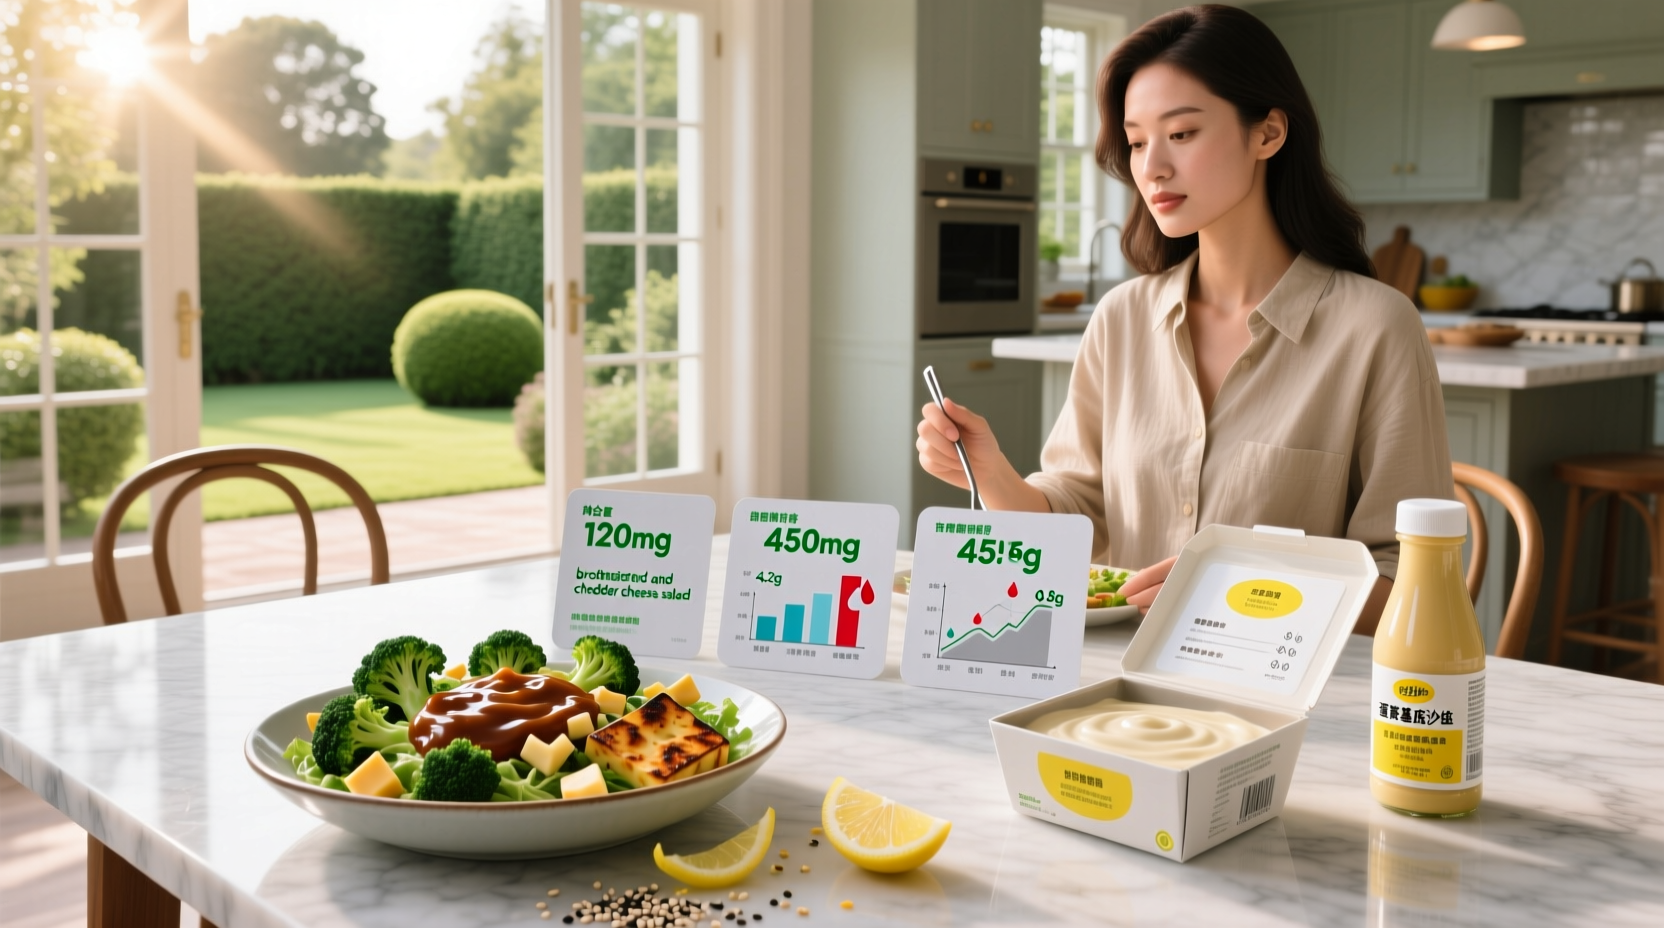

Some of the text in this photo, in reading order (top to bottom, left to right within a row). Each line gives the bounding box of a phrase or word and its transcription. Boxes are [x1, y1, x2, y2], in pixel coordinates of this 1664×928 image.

[585, 522, 672, 558] 120mg
[763, 527, 861, 563] 450mg
[651, 572, 674, 585] and
[755, 571, 783, 587] 4.2g
[661, 588, 691, 601] salad
